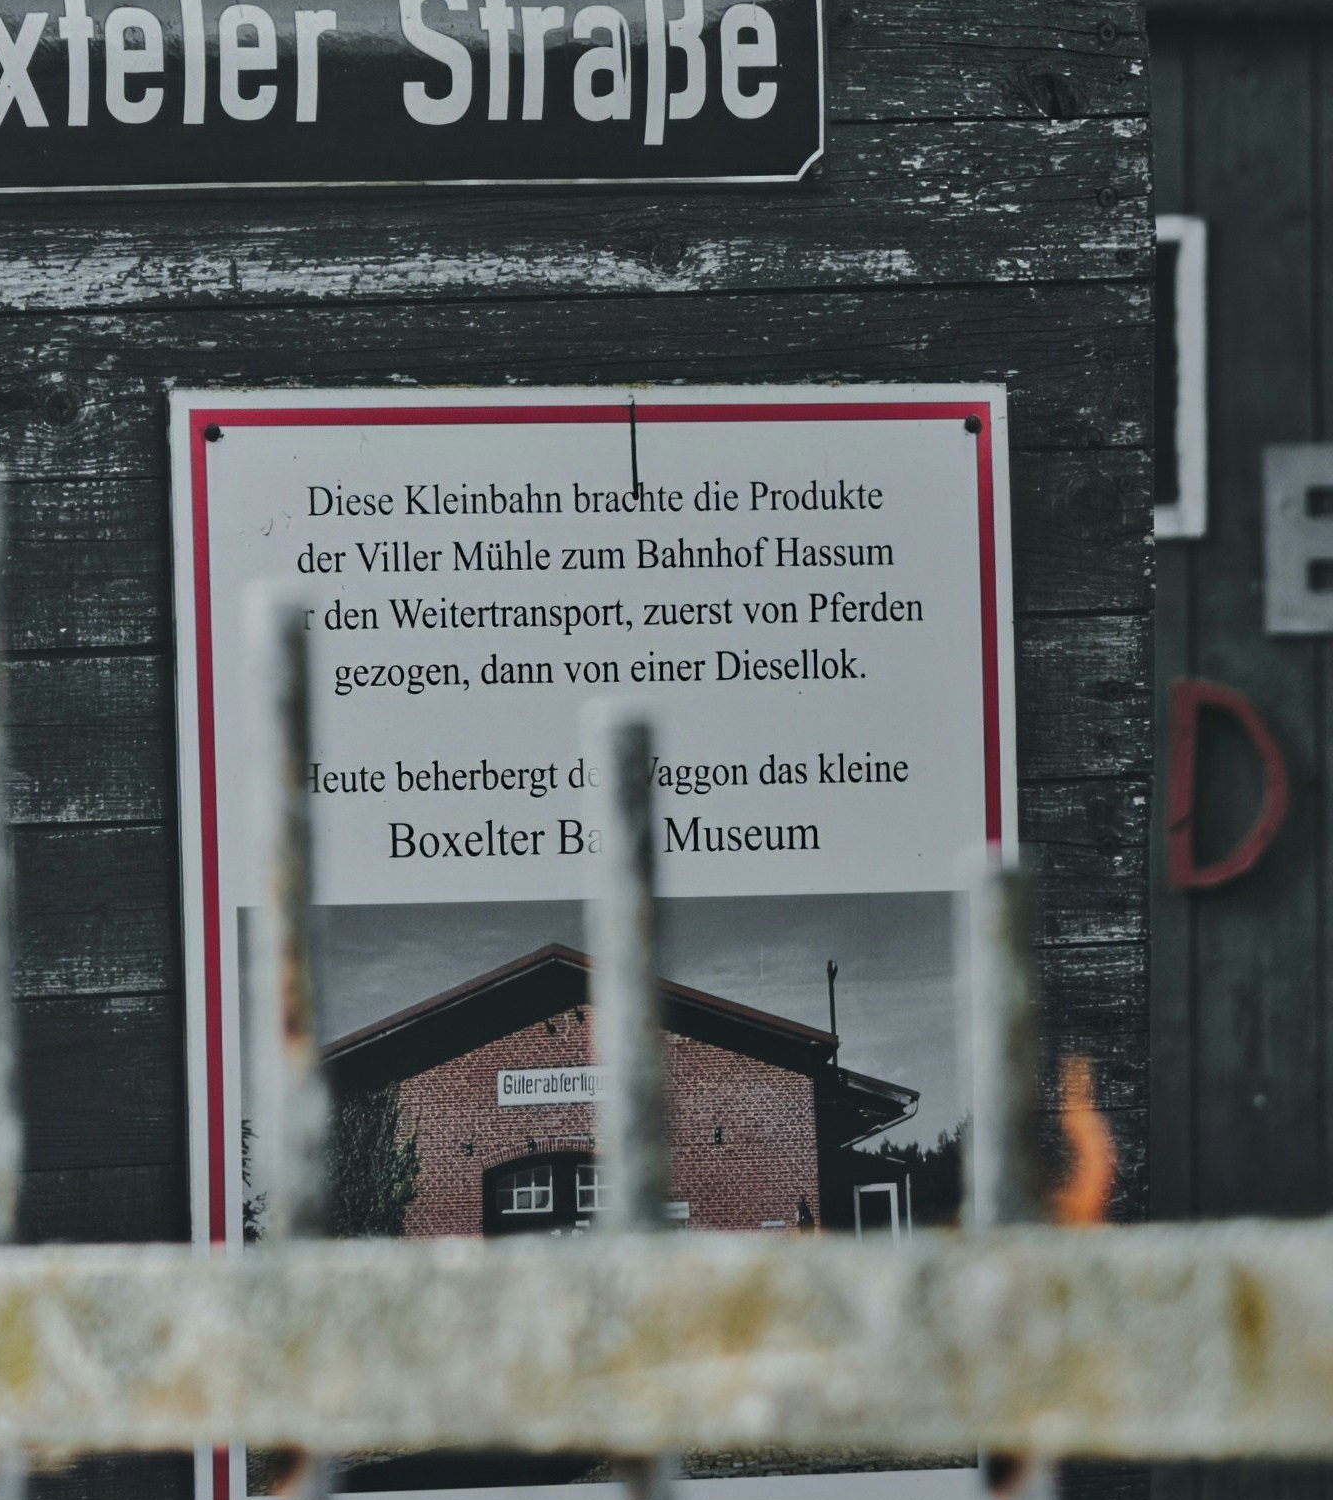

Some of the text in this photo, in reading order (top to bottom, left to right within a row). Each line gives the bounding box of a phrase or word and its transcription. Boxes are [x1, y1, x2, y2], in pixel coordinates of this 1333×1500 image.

[306, 478, 884, 516] Diese Kleinbahn brachte die Produkte
[296, 536, 895, 574] der Viller Mühle zum Bahnhof Hassum
[324, 598, 380, 631] den
[388, 597, 633, 636] Weitertransport,
[643, 599, 734, 627] zuerst
[743, 601, 799, 626] von
[808, 591, 924, 624] Pferden
[334, 648, 868, 696] gezogen, dann von einer Diesellok.
[395, 758, 559, 798] beherbergt
[758, 753, 808, 786] das
[817, 751, 909, 785] kleine
[388, 821, 545, 860] Boxelter
[663, 817, 821, 855] Museum
